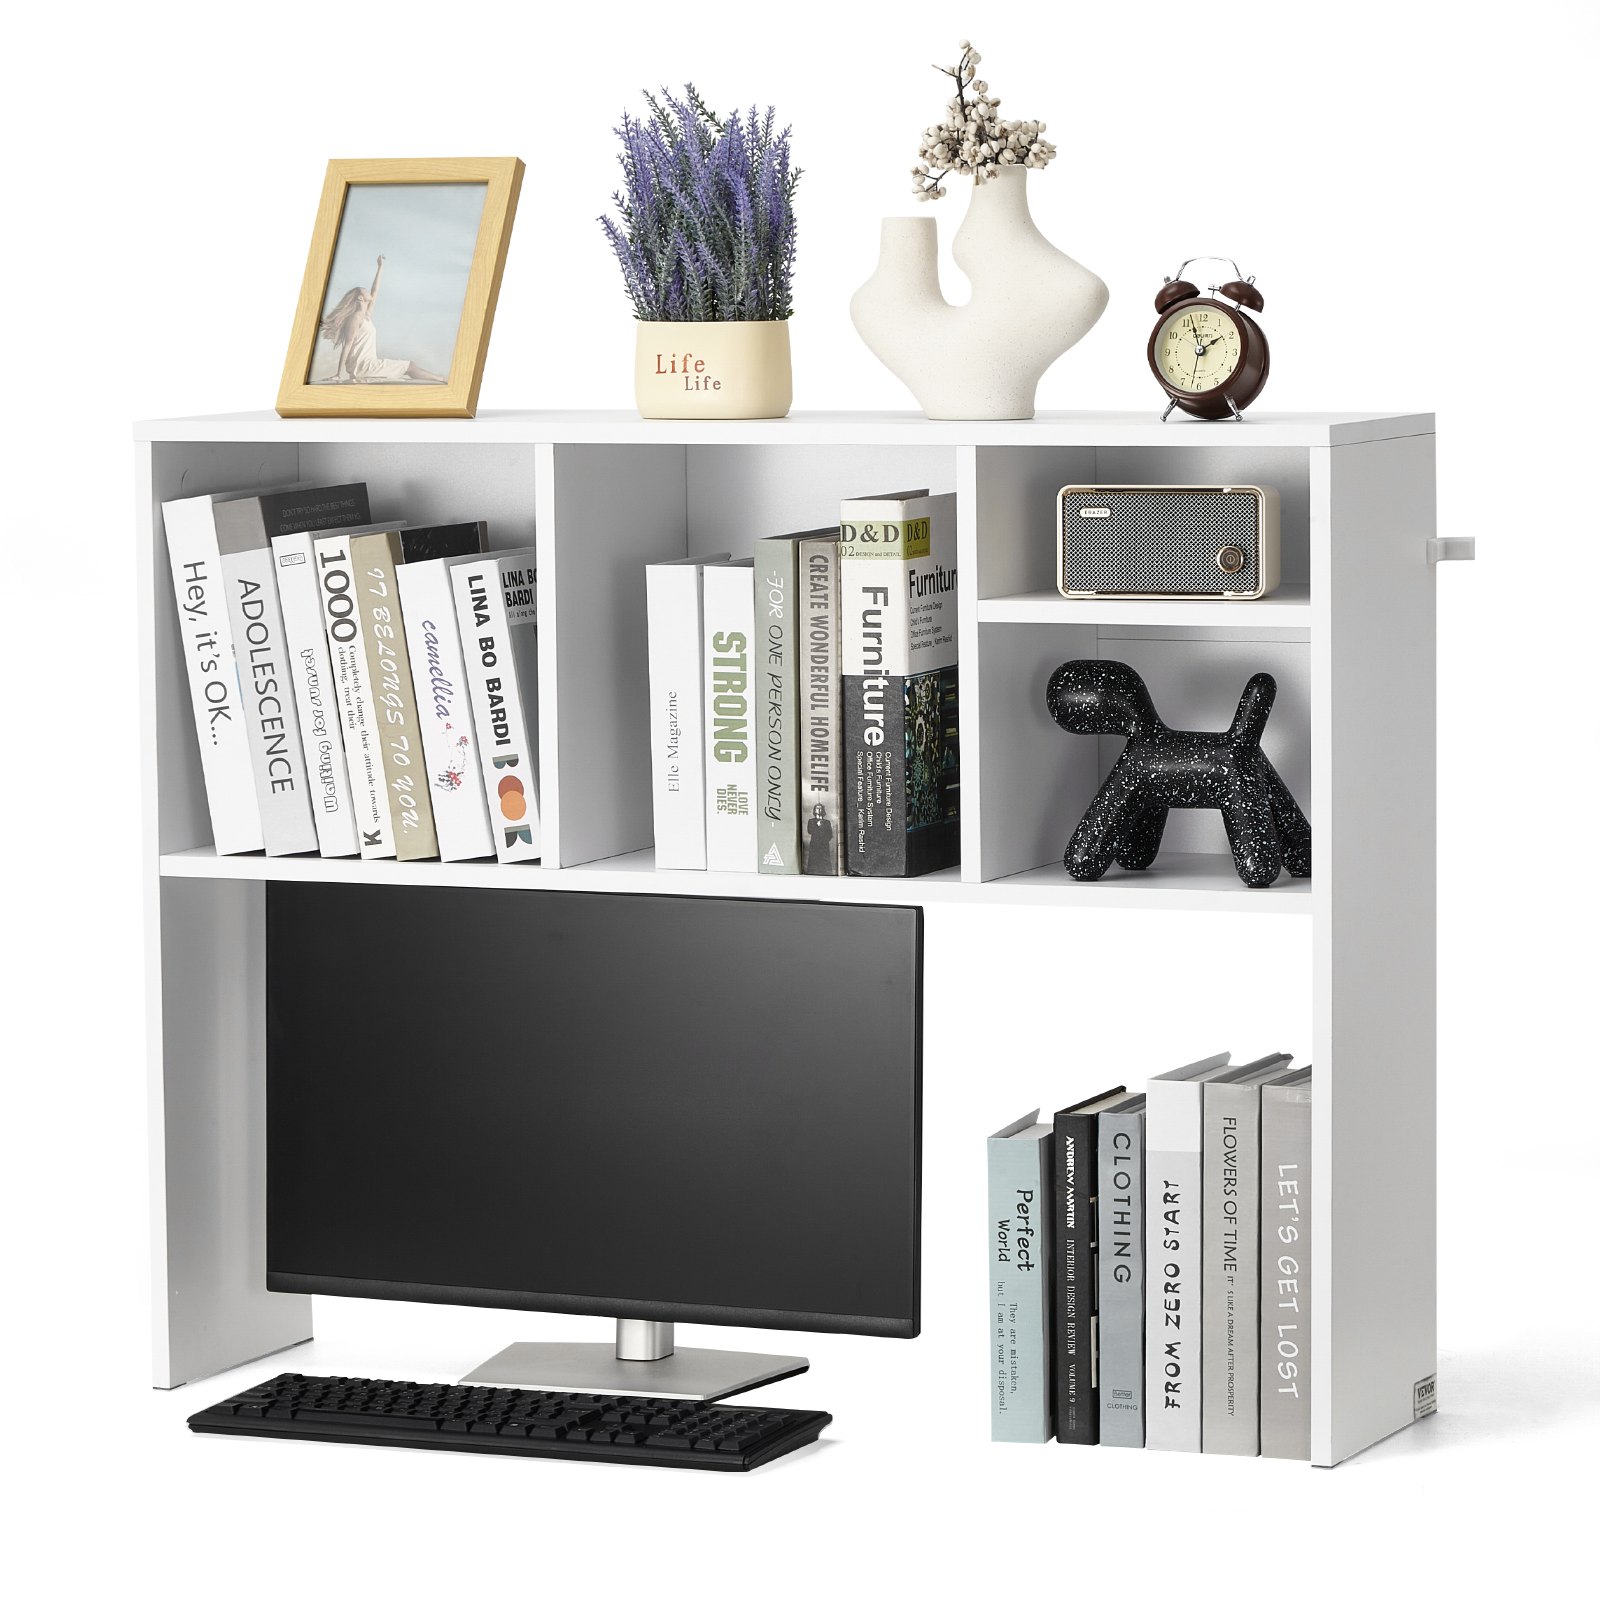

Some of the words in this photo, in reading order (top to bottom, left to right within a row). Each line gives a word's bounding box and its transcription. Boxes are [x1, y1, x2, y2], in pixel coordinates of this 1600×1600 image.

[1200, 314, 1208, 322] 12
[656, 353, 706, 374] Life
[685, 376, 722, 391] Life
[841, 546, 855, 557] 02
[183, 561, 207, 622] Hey,
[320, 549, 357, 642] 1000
[367, 568, 388, 598] IT
[468, 574, 491, 627] LINA
[502, 570, 525, 588] LINA
[505, 589, 534, 607] BARDI
[809, 554, 829, 610] CREATE
[909, 564, 957, 598] Furnitur
[195, 631, 218, 672] it's
[373, 605, 404, 726] BELONGS
[478, 636, 497, 668] BO
[768, 624, 783, 666] ONE
[809, 615, 829, 711] WONDERFUL
[862, 586, 888, 747] Furniture
[237, 578, 295, 794] ADOLESCENCE
[301, 648, 322, 706] sunset
[338, 646, 349, 683] clothing,
[348, 709, 356, 730] their
[348, 645, 362, 694] Completely
[422, 620, 455, 719] camellia
[204, 681, 232, 746] OK...
[356, 697, 366, 726] change
[486, 678, 511, 746] BARDI
[712, 632, 748, 762] STRONG
[767, 673, 783, 761] PERSON
[313, 709, 327, 736] for
[361, 730, 369, 751] their
[666, 691, 681, 758] Magazine
[364, 753, 375, 787] attitude
[388, 735, 409, 767] TO
[810, 717, 829, 792] HOMELIFE
[319, 740, 339, 813] Waiting
[668, 766, 679, 792] Elle
[369, 790, 379, 824] towards
[391, 775, 419, 834] YOU.
[716, 788, 727, 815] DIES.
[727, 784, 738, 815] NEVER
[738, 792, 748, 816] LOVE
[1066, 1136, 1075, 1186] ANDREW
[1223, 1117, 1237, 1196] FLOWERS
[1066, 1186, 1075, 1228] MARTIN
[1113, 1133, 1132, 1283] CLOTHING
[1163, 1180, 1180, 1252] START
[1224, 1200, 1237, 1225] OF
[1277, 1164, 1299, 1243] LET'S
[998, 1219, 1010, 1262] World
[1016, 1189, 1034, 1272] Perfect
[1224, 1230, 1237, 1272] TIME
[1066, 1240, 1075, 1282] INTERIOR
[1067, 1286, 1076, 1319] DESIGN
[1164, 1262, 1182, 1330] ZERO
[1277, 1255, 1299, 1313] GET
[998, 1313, 1003, 1324] am
[998, 1328, 1004, 1339] at
[1067, 1323, 1076, 1356] REVIEW
[1164, 1342, 1182, 1409] FROM
[1277, 1324, 1299, 1399] LOST
[998, 1370, 1008, 1414] disposal.
[1417, 1381, 1435, 1399] VEVOR
